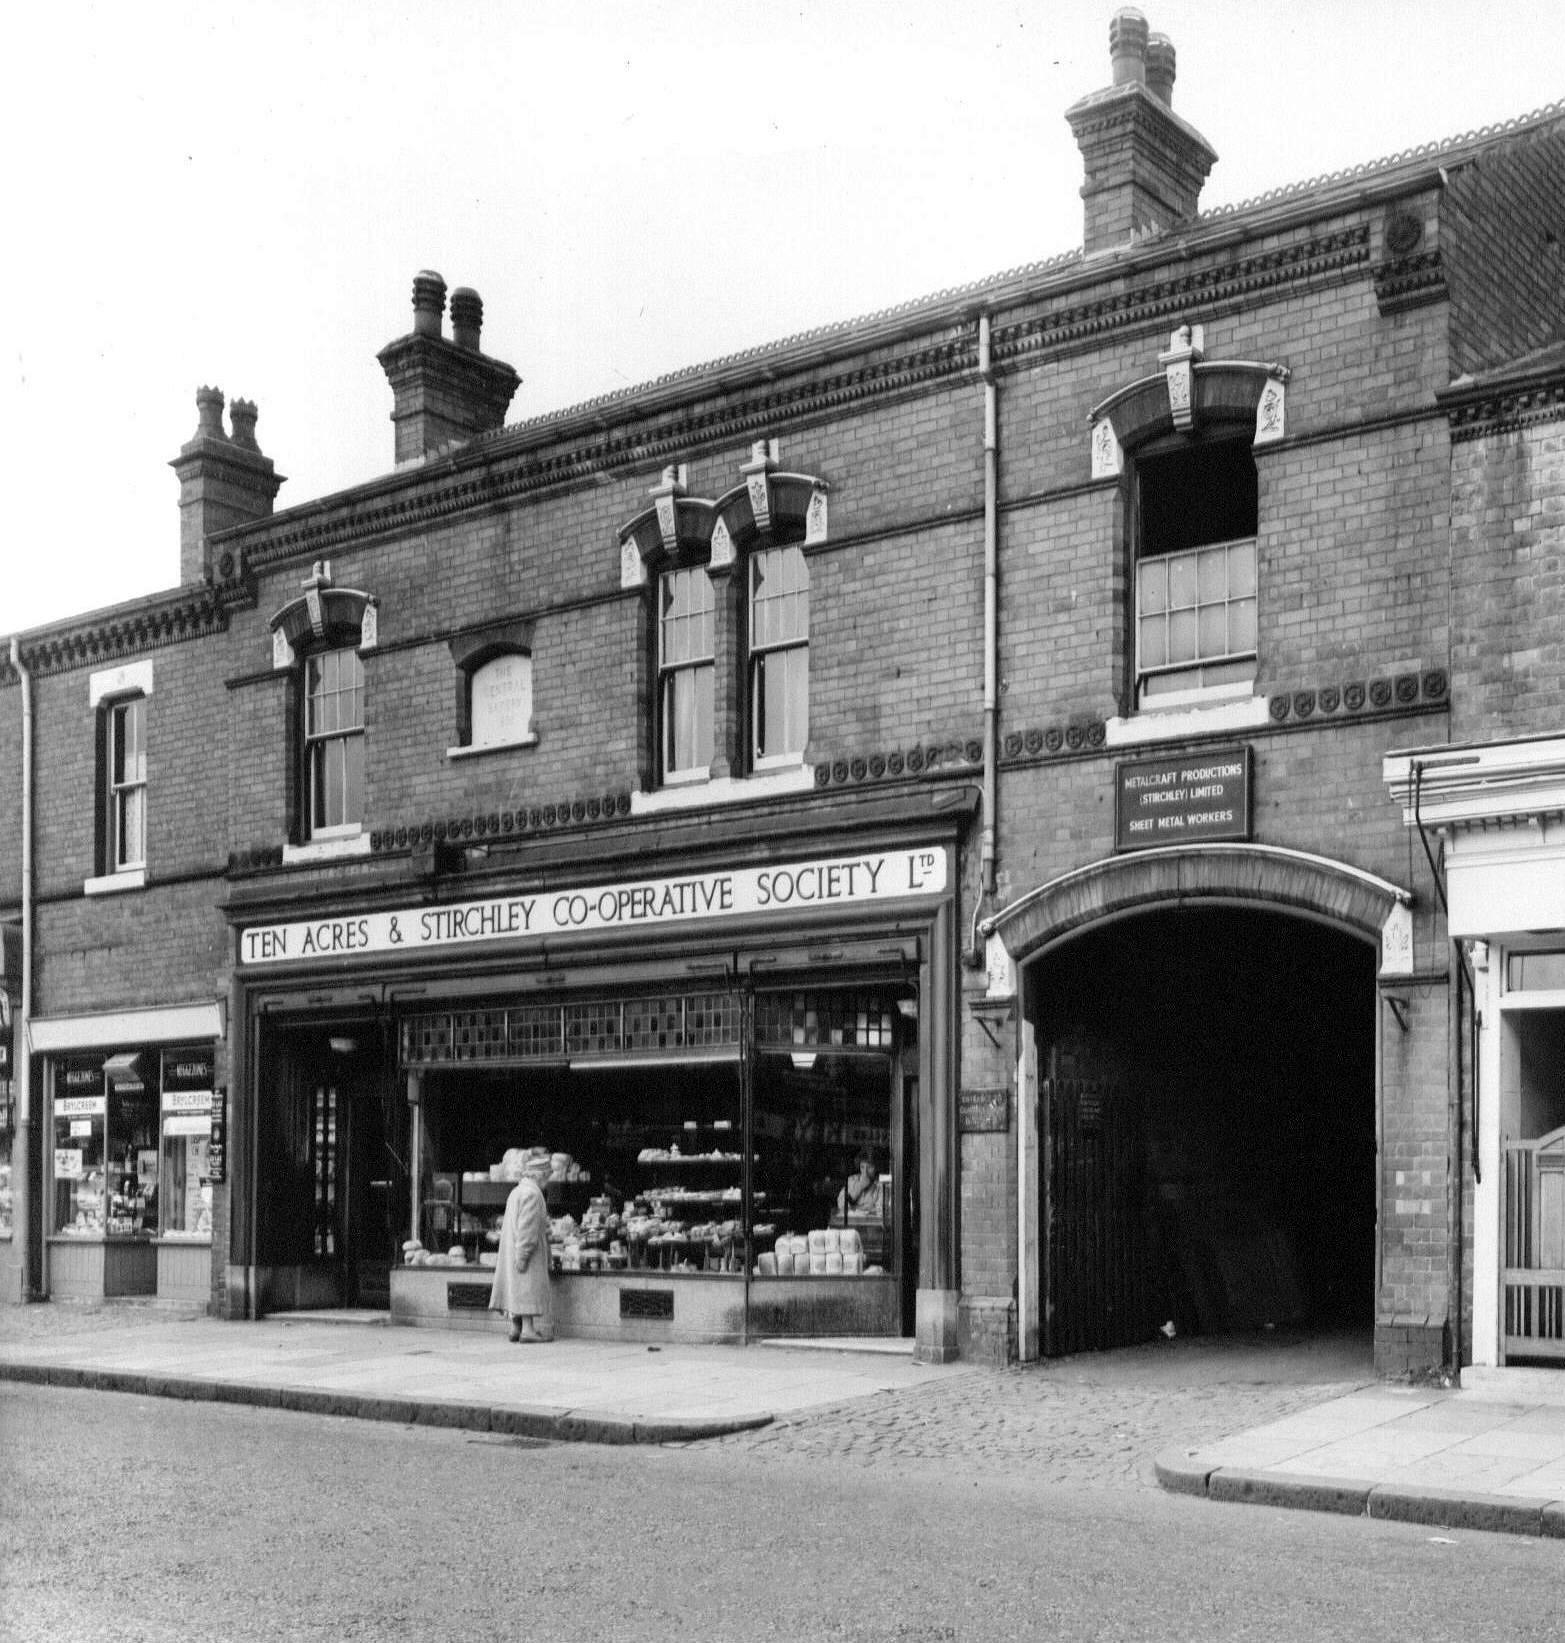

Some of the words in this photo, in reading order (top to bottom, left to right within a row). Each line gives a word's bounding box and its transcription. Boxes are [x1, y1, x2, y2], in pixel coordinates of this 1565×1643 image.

[1124, 771, 1177, 790] METALCRAFT
[1181, 763, 1242, 782] PRODUCTIONS
[1190, 784, 1224, 799] LIMITED
[1129, 818, 1154, 832] SHEET
[1158, 816, 1184, 829] METAL
[1187, 810, 1233, 825] WORKERS
[246, 928, 287, 960] TEN
[302, 920, 369, 954] ACRES
[389, 916, 403, 944] &
[421, 900, 536, 941] STIRCHLEY
[553, 877, 733, 927] CO-OPERATIVE
[757, 859, 885, 906] SOCIETY
